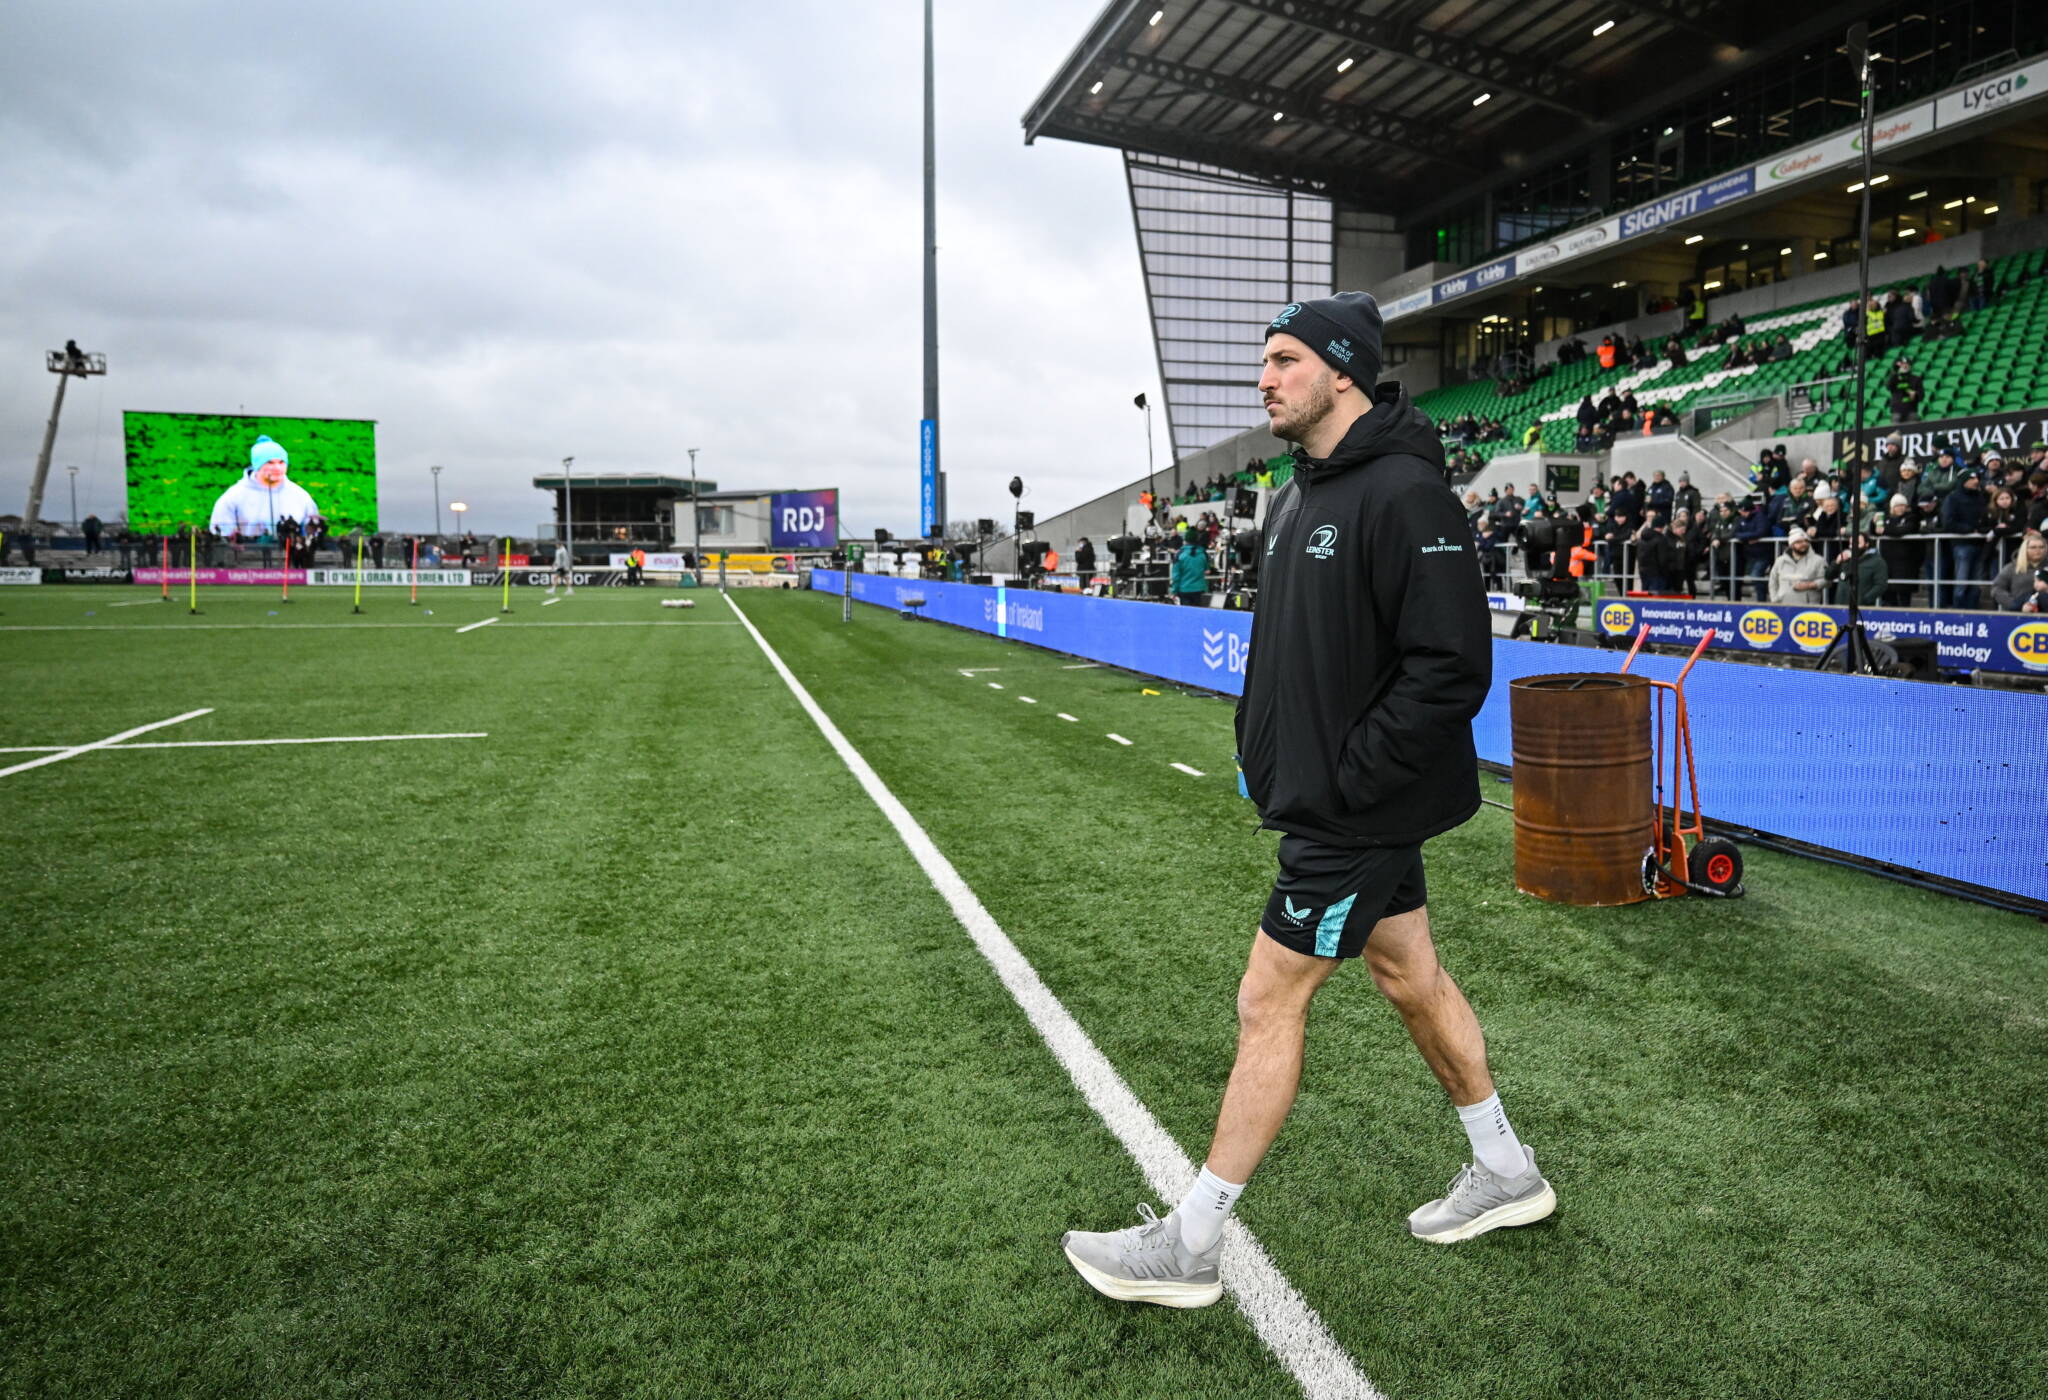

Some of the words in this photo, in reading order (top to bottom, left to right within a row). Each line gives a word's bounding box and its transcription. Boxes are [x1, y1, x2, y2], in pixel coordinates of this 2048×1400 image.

[1963, 78, 2012, 109] Lyca
[1866, 121, 1913, 144] allagher
[1624, 190, 1702, 236] SIGNFIT
[1327, 346, 1350, 363] Ireland
[1331, 340, 1347, 354] Bank
[783, 506, 825, 533] RDJ
[1305, 546, 1335, 557] LEINSTER
[332, 572, 393, 583] O'HALORAN
[407, 573, 443, 583] OBRIEN
[448, 573, 464, 583] LTD
[1604, 611, 1632, 626] CBE
[1641, 607, 1685, 621] Innovators
[1687, 609, 1695, 621] in
[1697, 610, 1722, 623] Retail
[1724, 611, 1732, 623] &
[1743, 617, 1779, 636] CBE
[1793, 620, 1833, 639] CBE
[1919, 620, 1931, 634] in
[1935, 621, 1973, 637] Retail
[1977, 623, 1989, 638] &
[1937, 642, 1992, 663] hnology
